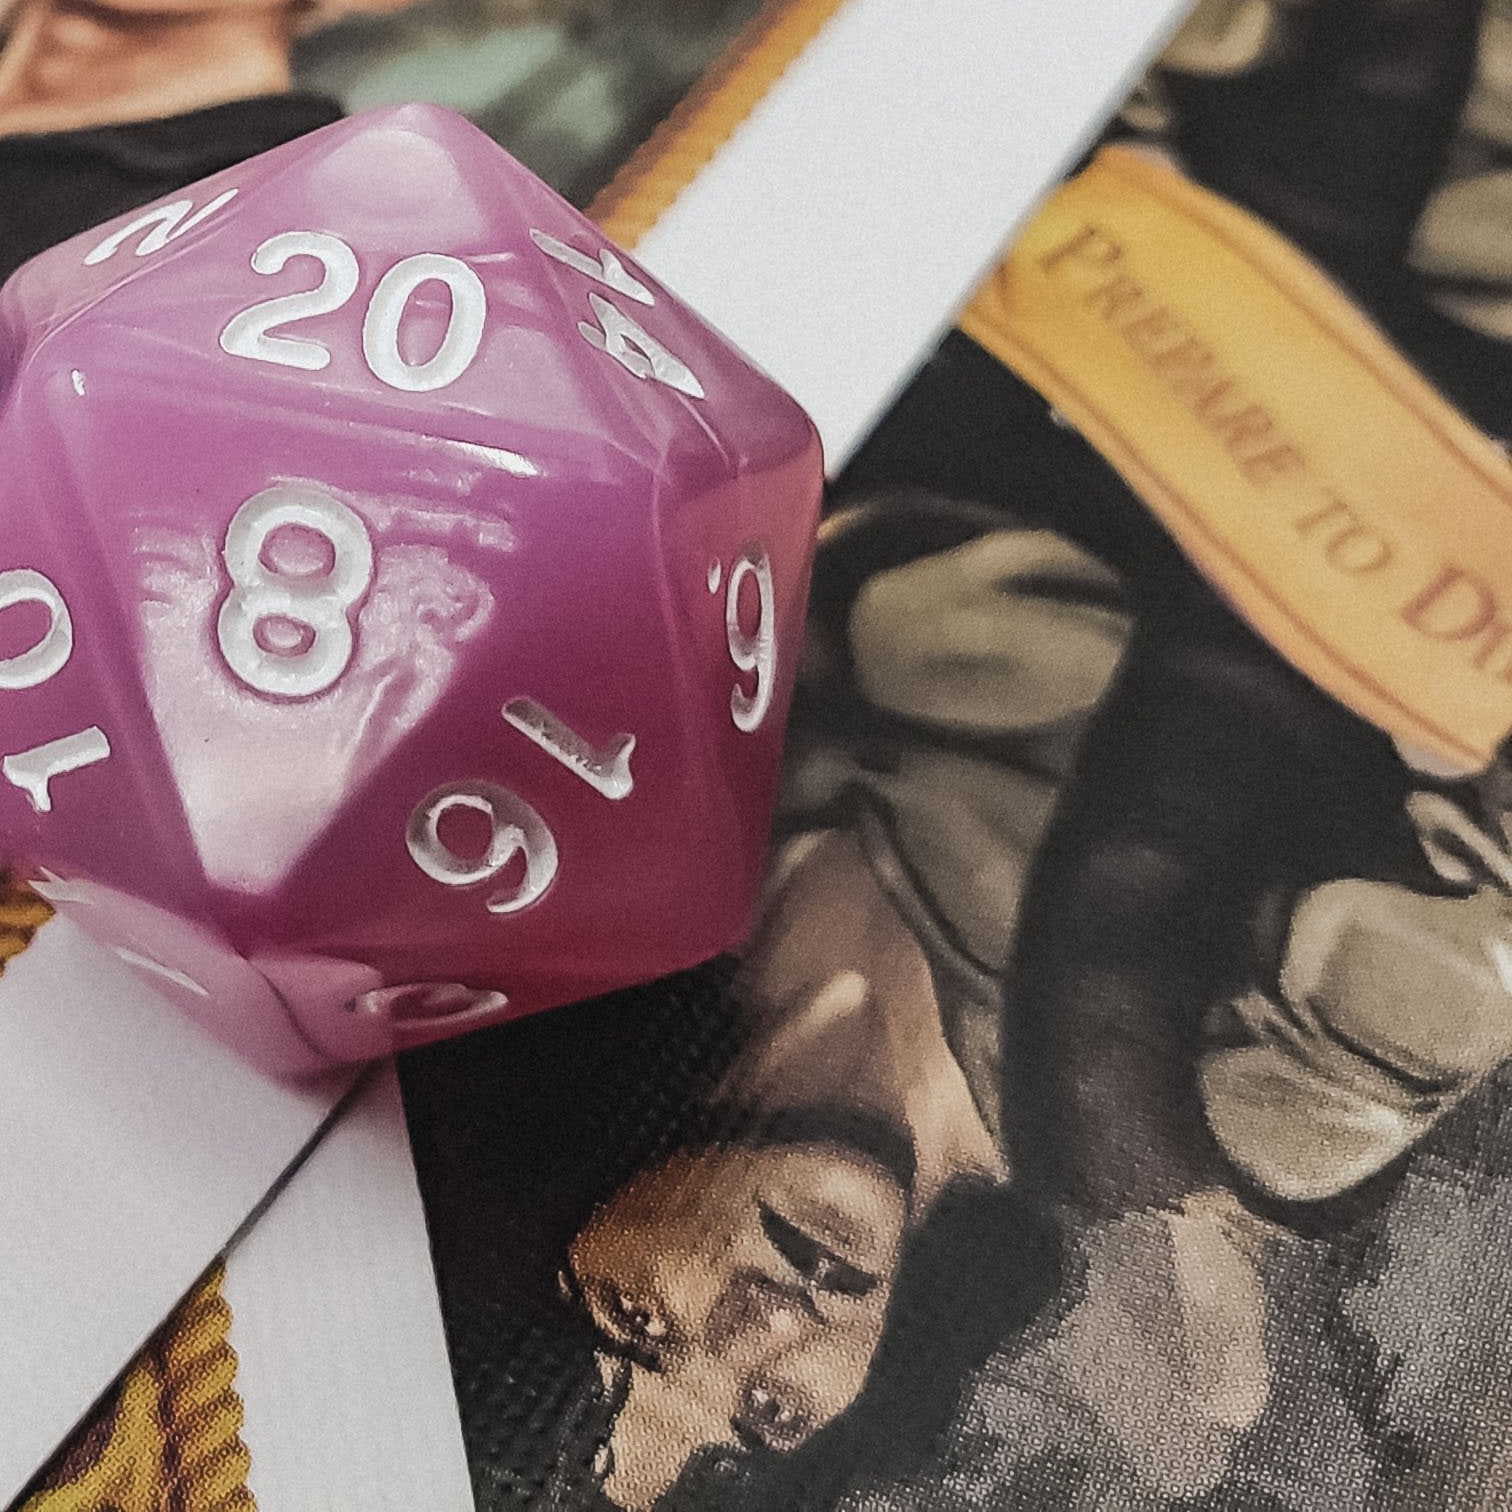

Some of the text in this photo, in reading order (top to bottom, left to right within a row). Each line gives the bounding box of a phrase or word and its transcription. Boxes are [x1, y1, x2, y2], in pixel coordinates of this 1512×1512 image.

[220, 229, 487, 393] 20
[528, 226, 706, 400] 14
[1036, 221, 1310, 488] PREPARE
[1294, 491, 1394, 578] TO
[216, 485, 375, 697] 8
[404, 696, 637, 915] 16
